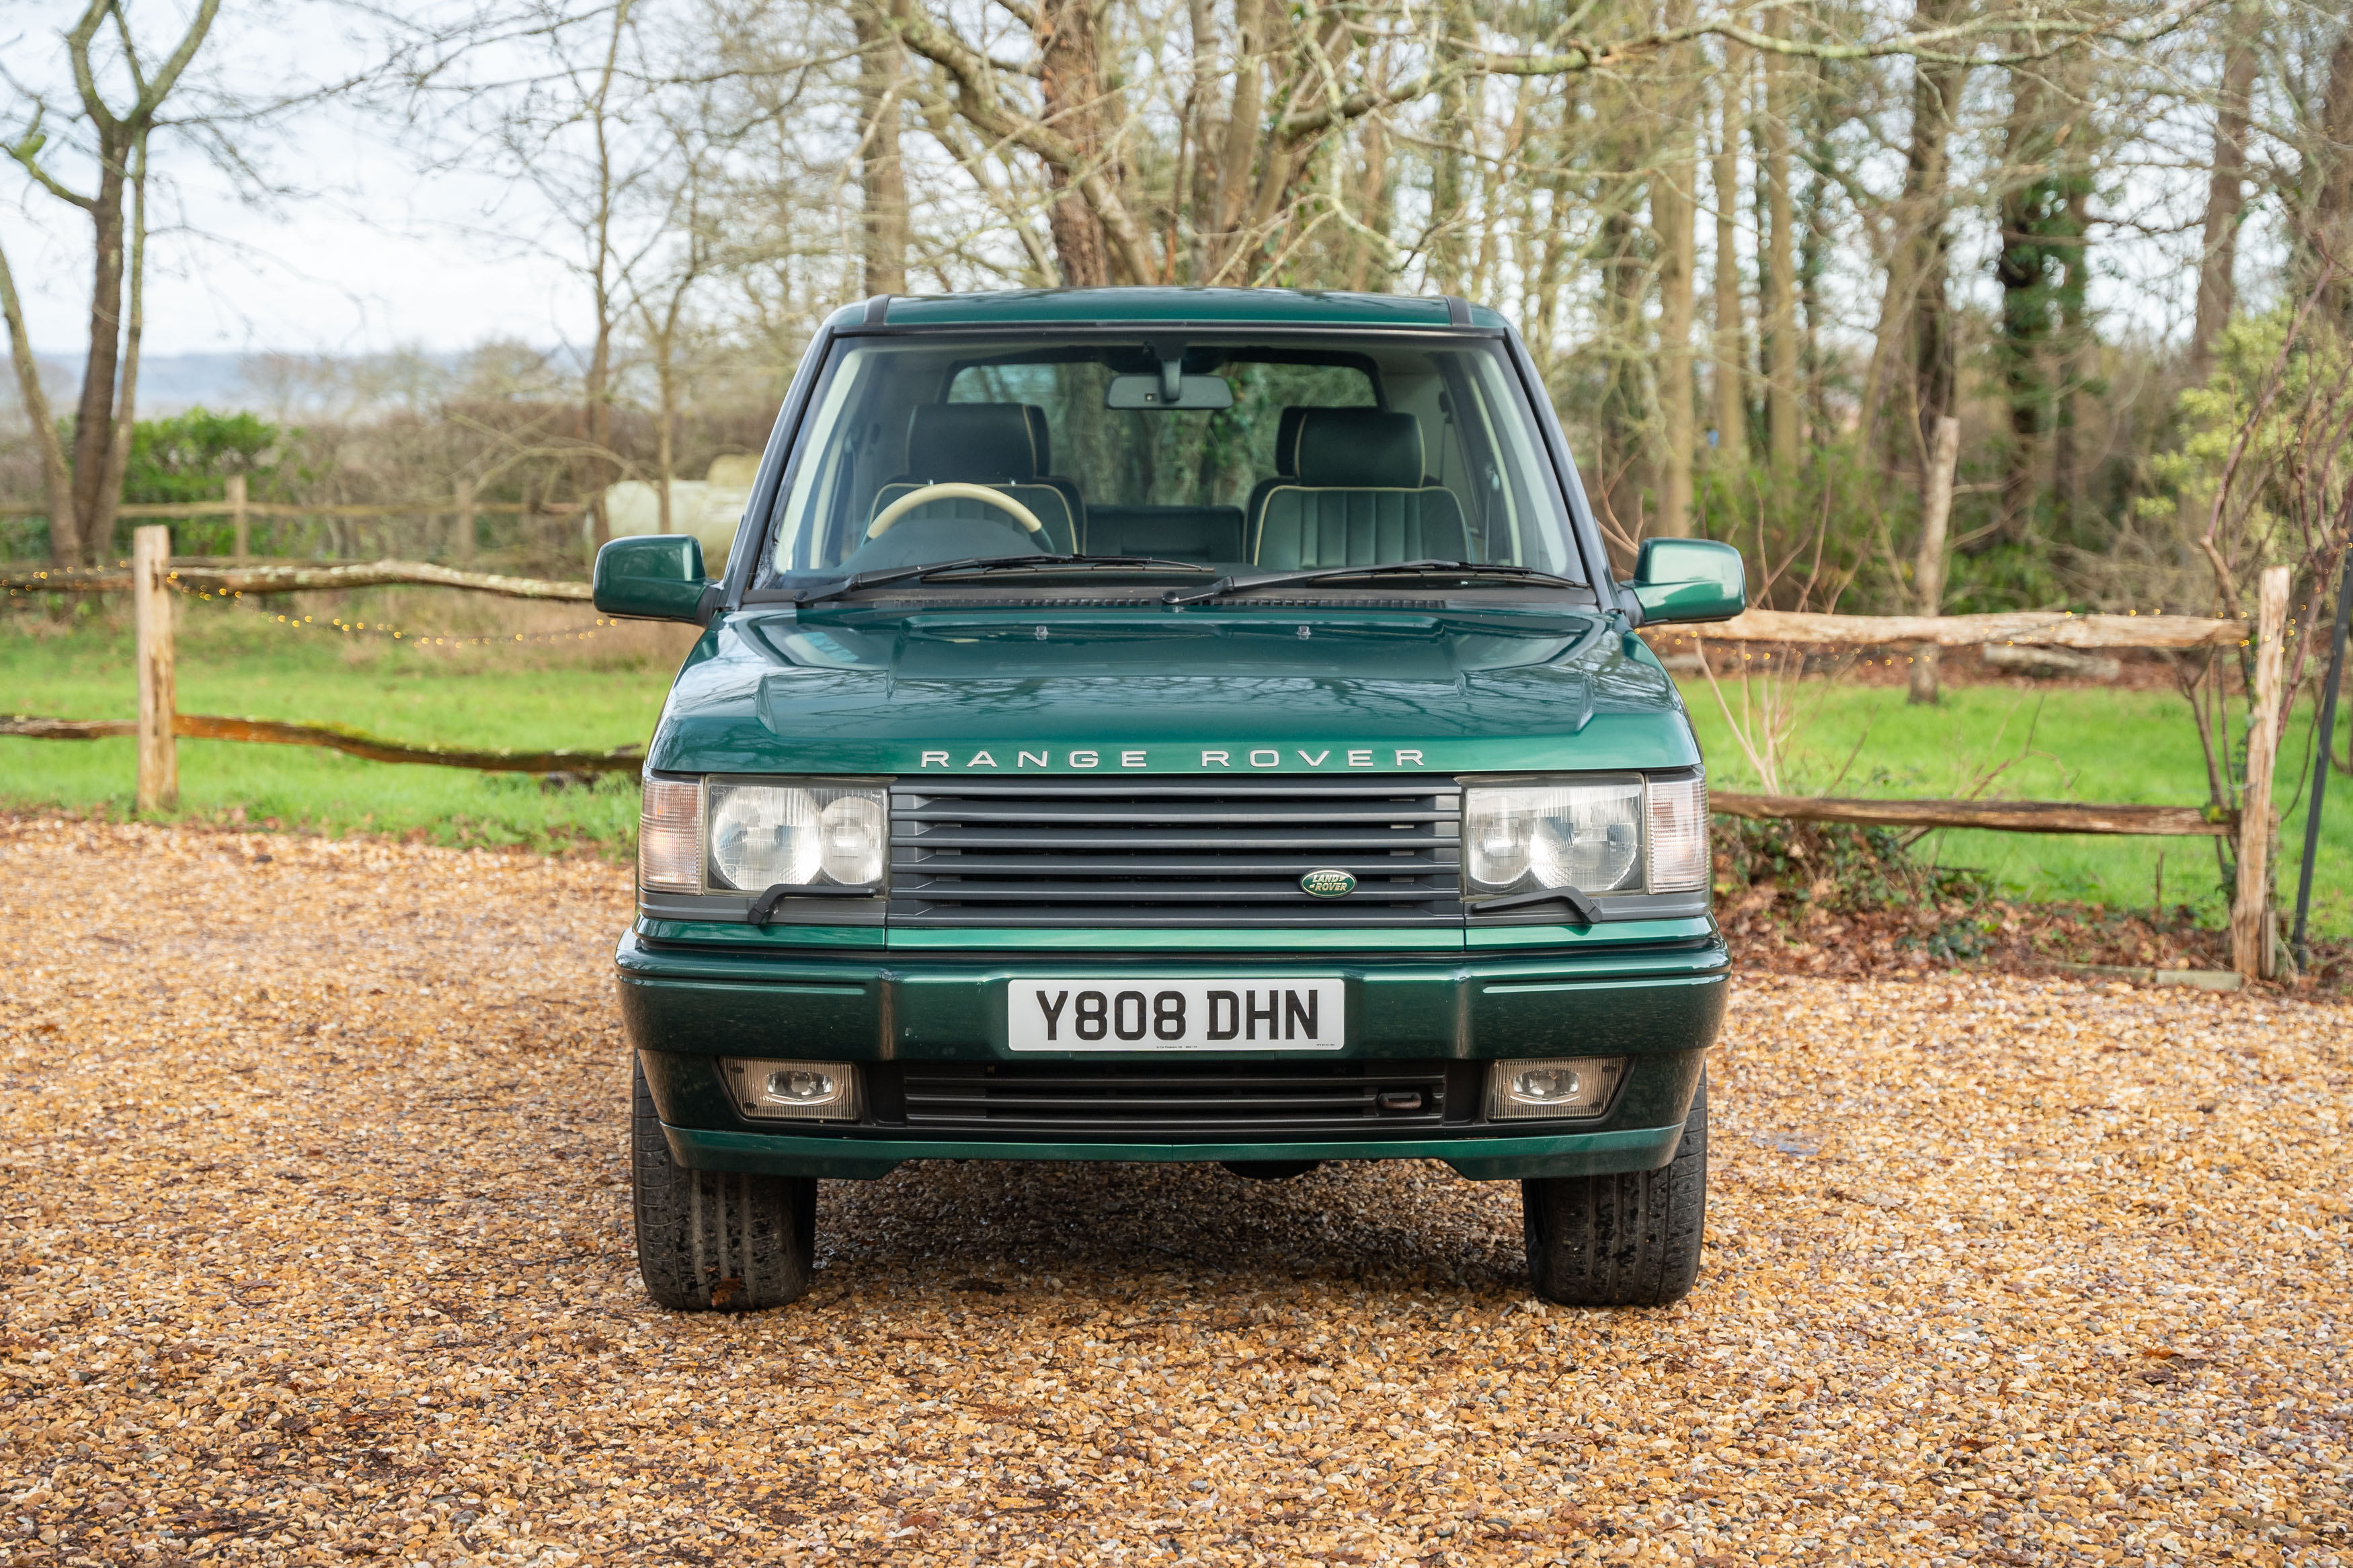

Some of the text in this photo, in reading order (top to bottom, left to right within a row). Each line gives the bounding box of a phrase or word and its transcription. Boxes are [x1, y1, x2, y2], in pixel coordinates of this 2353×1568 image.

[920, 749, 1425, 768] RANGE ROVER
[1312, 874, 1339, 882] LAND
[1314, 882, 1347, 891] ROVER
[1035, 989, 1318, 1040] Y808 DHN
